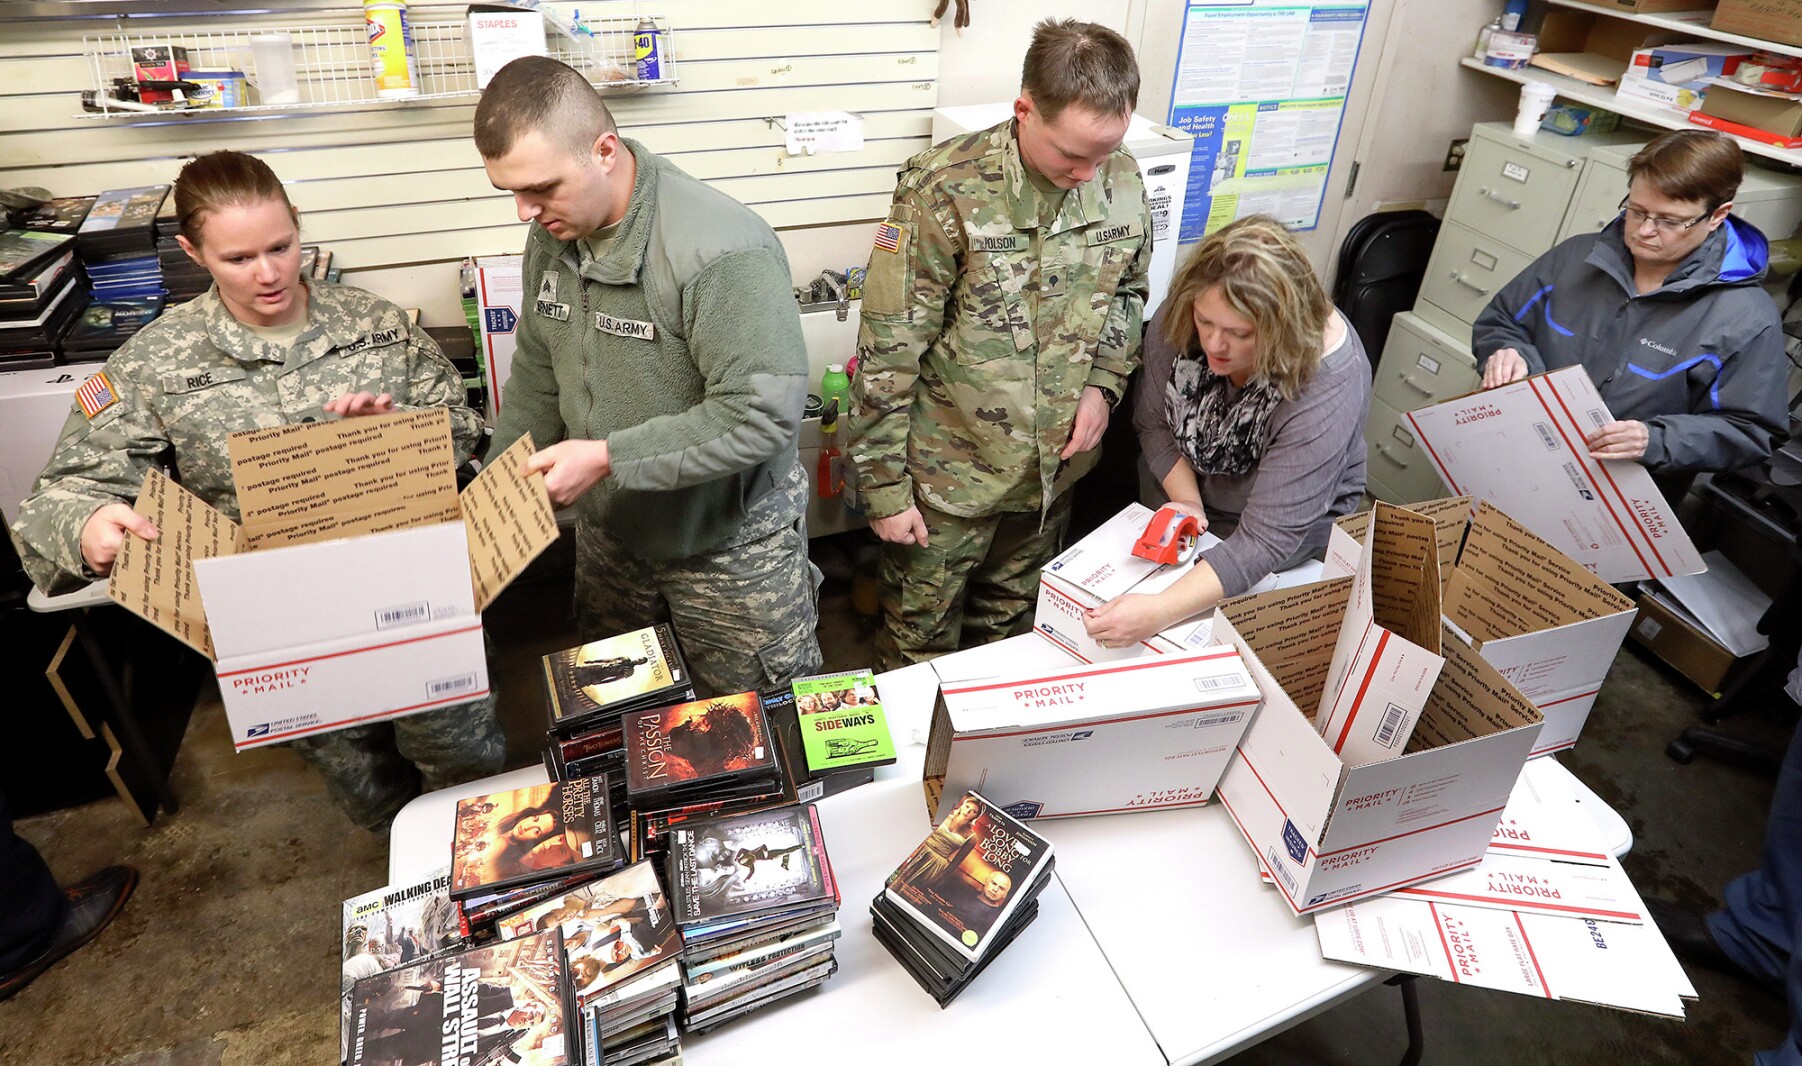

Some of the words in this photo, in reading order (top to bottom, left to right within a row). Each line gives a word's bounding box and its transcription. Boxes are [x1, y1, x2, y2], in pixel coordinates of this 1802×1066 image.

[477, 20, 517, 28] STAPLES
[1178, 116, 1192, 124] Job
[1194, 115, 1216, 123] Safety
[372, 329, 400, 343] ARMY
[186, 372, 213, 388] RICE
[1455, 409, 1502, 425] PRIORITY
[1461, 404, 1487, 415] MAIL
[237, 452, 271, 466] postage
[273, 442, 308, 457] required
[336, 430, 362, 440] Thank
[364, 425, 379, 434] you
[380, 422, 392, 430] for
[393, 416, 414, 427] using
[249, 431, 280, 444] Priority
[258, 457, 290, 469] Priority
[315, 441, 348, 455] postage
[349, 433, 383, 446] required
[411, 420, 435, 431] Thank
[247, 477, 280, 491] postage
[282, 468, 317, 482] required
[345, 455, 370, 465] Thank
[372, 449, 387, 459] you
[401, 441, 422, 452] using
[268, 481, 299, 494] Priority
[323, 467, 355, 480] postage
[357, 458, 391, 471] required
[417, 446, 442, 455] Thank
[256, 502, 290, 516] postage
[291, 492, 326, 506] required
[353, 477, 379, 489] Thank
[409, 465, 429, 476] using
[277, 505, 309, 518] Priority
[332, 491, 364, 505] postage
[365, 482, 399, 495] required
[1631, 498, 1663, 539] PRIORITY
[1645, 507, 1664, 528] MAIL
[1082, 562, 1112, 586] PRIORITY
[1095, 573, 1113, 585] MAIL
[1045, 589, 1085, 617] PRIORITY
[1053, 602, 1074, 619] MAIL
[641, 633, 663, 681] GLADIATOR
[233, 667, 311, 688] PRIORITY
[254, 680, 294, 694] MAIL
[1014, 683, 1086, 701] PRIORITY
[1035, 696, 1075, 709] MAIL
[270, 725, 292, 733] POSTAL
[271, 718, 294, 726] UNITED
[296, 713, 317, 722] STATES
[815, 715, 875, 732] SIDEWAYS
[638, 720, 642, 729] OF
[640, 749, 649, 780] CHRIST
[640, 714, 667, 779] PASSION
[662, 735, 672, 752] THE
[569, 779, 584, 818] PRETTY
[583, 789, 591, 804] THE
[1126, 791, 1203, 806] PRIORITY
[1148, 786, 1190, 798] MAIL
[1345, 788, 1400, 806] PRIORITY
[562, 786, 575, 824] HORSES
[593, 797, 601, 817] THOMAS
[1355, 799, 1383, 811] MAIL
[688, 830, 696, 856] DANCE
[989, 826, 1017, 846] LOVE
[596, 839, 604, 855] BLACK
[980, 838, 1018, 863] BOBBY
[989, 834, 1020, 859] SONG
[1321, 846, 1379, 867] PRIORITY
[820, 855, 830, 886] WIDESCREEN
[981, 851, 1012, 874] LONG
[1332, 859, 1361, 870] MAIL
[691, 877, 699, 894] THE
[1498, 872, 1538, 885] MAIL
[384, 881, 432, 906] WALKING
[1488, 882, 1562, 899] PRIORITY
[693, 894, 701, 916] SAVE
[1505, 926, 1515, 939] BOX
[1442, 914, 1472, 976] PRIORITY
[1463, 930, 1479, 963] MAIL
[1513, 939, 1523, 955] RATE
[729, 957, 766, 972] WITLESS
[768, 943, 806, 960] PROTECTION
[1519, 956, 1529, 971] FLAT
[1523, 971, 1534, 987] LARGE
[443, 962, 461, 1018] WALL
[359, 1008, 368, 1032] POWER
[460, 967, 481, 1054] ASSAULT
[356, 1033, 365, 1059] GREED
